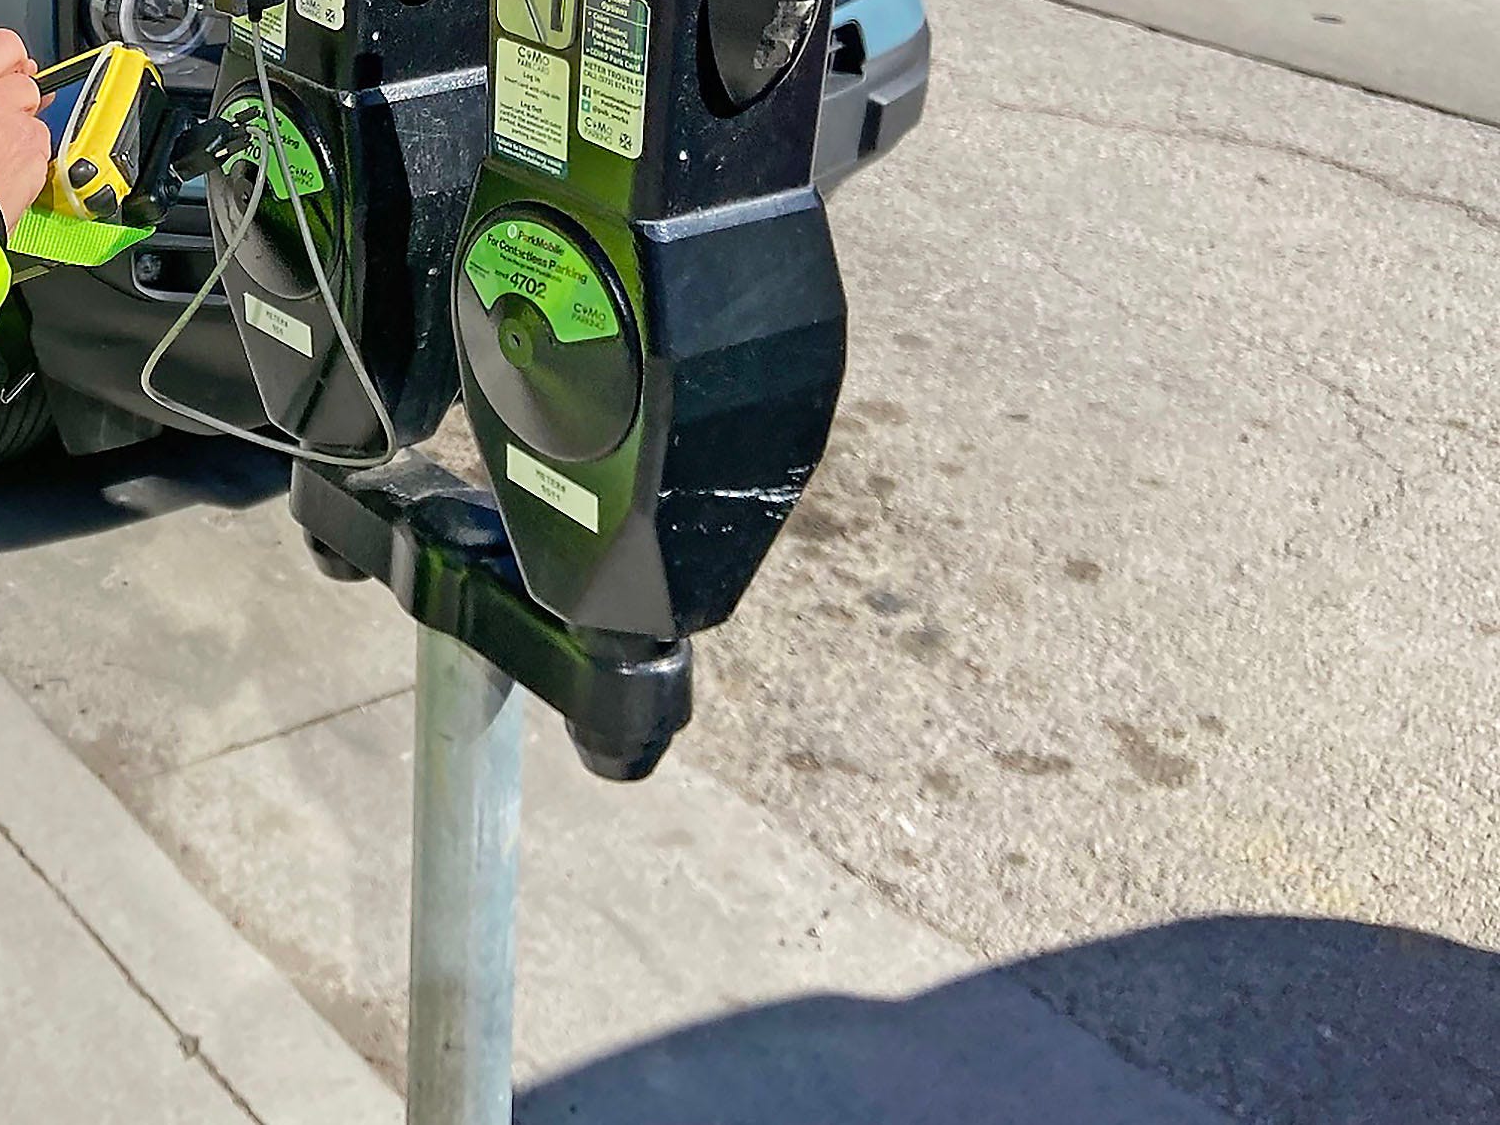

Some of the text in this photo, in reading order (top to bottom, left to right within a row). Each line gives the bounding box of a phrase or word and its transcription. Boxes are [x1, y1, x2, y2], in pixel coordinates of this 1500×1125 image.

[583, 60, 645, 88] METER TROUBLE?
[518, 230, 565, 256] ParkMobile
[487, 233, 499, 247] For
[499, 239, 548, 268] Contactless
[548, 259, 588, 285] Parking
[510, 272, 547, 299] 4702
